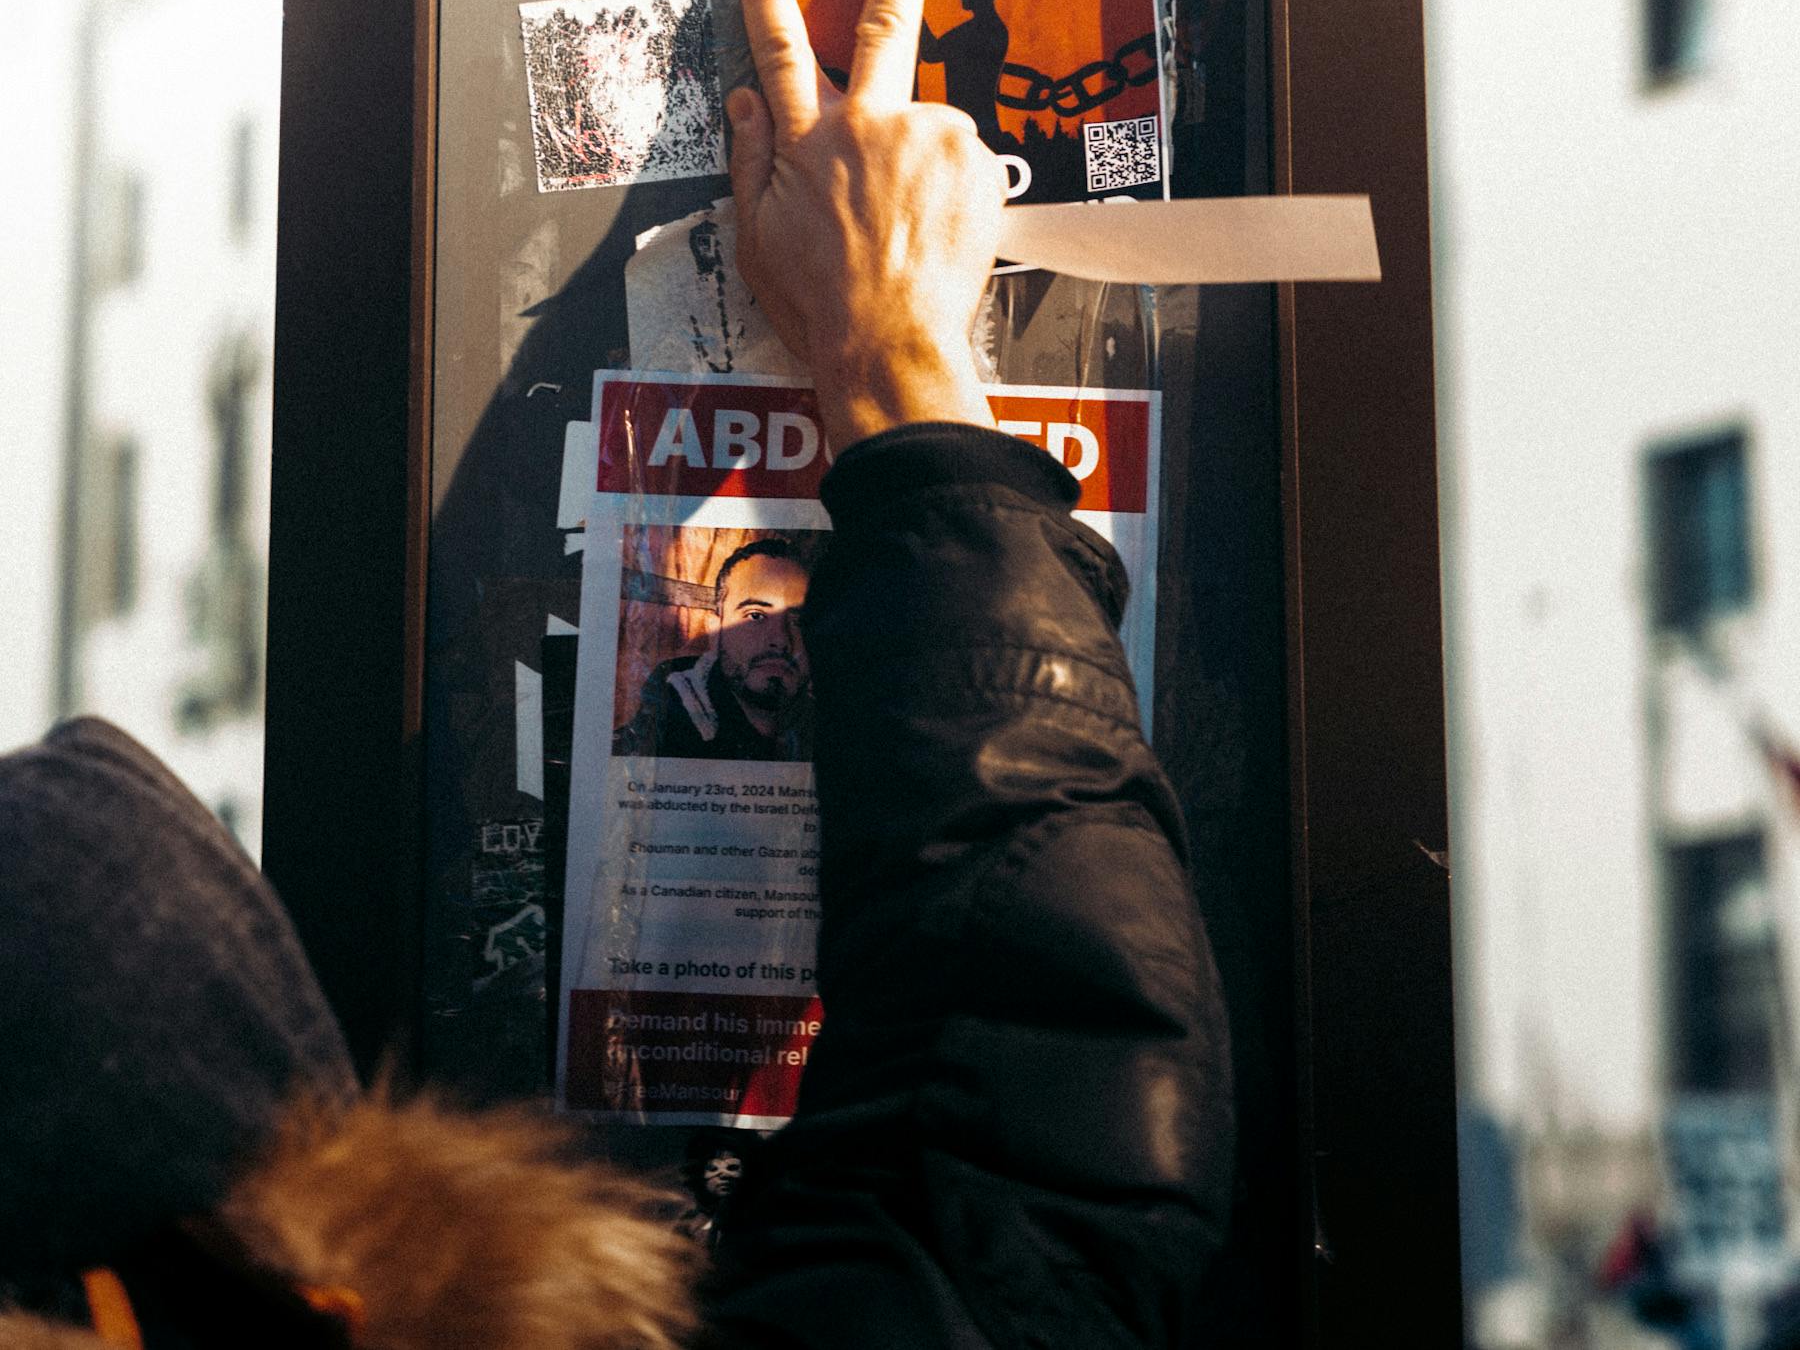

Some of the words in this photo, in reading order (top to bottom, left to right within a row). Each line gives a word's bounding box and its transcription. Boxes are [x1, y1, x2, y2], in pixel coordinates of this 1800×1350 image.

[649, 782, 701, 798] January
[705, 784, 738, 798] 23rd,
[742, 785, 774, 797] 2024
[647, 799, 707, 812] abducted
[712, 802, 727, 815] by
[730, 802, 751, 813] the
[754, 804, 788, 815] Israel
[693, 844, 718, 856] and
[721, 846, 754, 858] other
[650, 885, 712, 899] Canadian
[715, 888, 761, 902] citizen,
[735, 908, 784, 920] support
[788, 908, 802, 919] of
[609, 958, 652, 975] Take
[658, 962, 669, 974] a
[674, 960, 730, 979] photo
[736, 962, 756, 978] of
[760, 963, 795, 980] this
[609, 1009, 707, 1032] Demand
[714, 1012, 749, 1034] his
